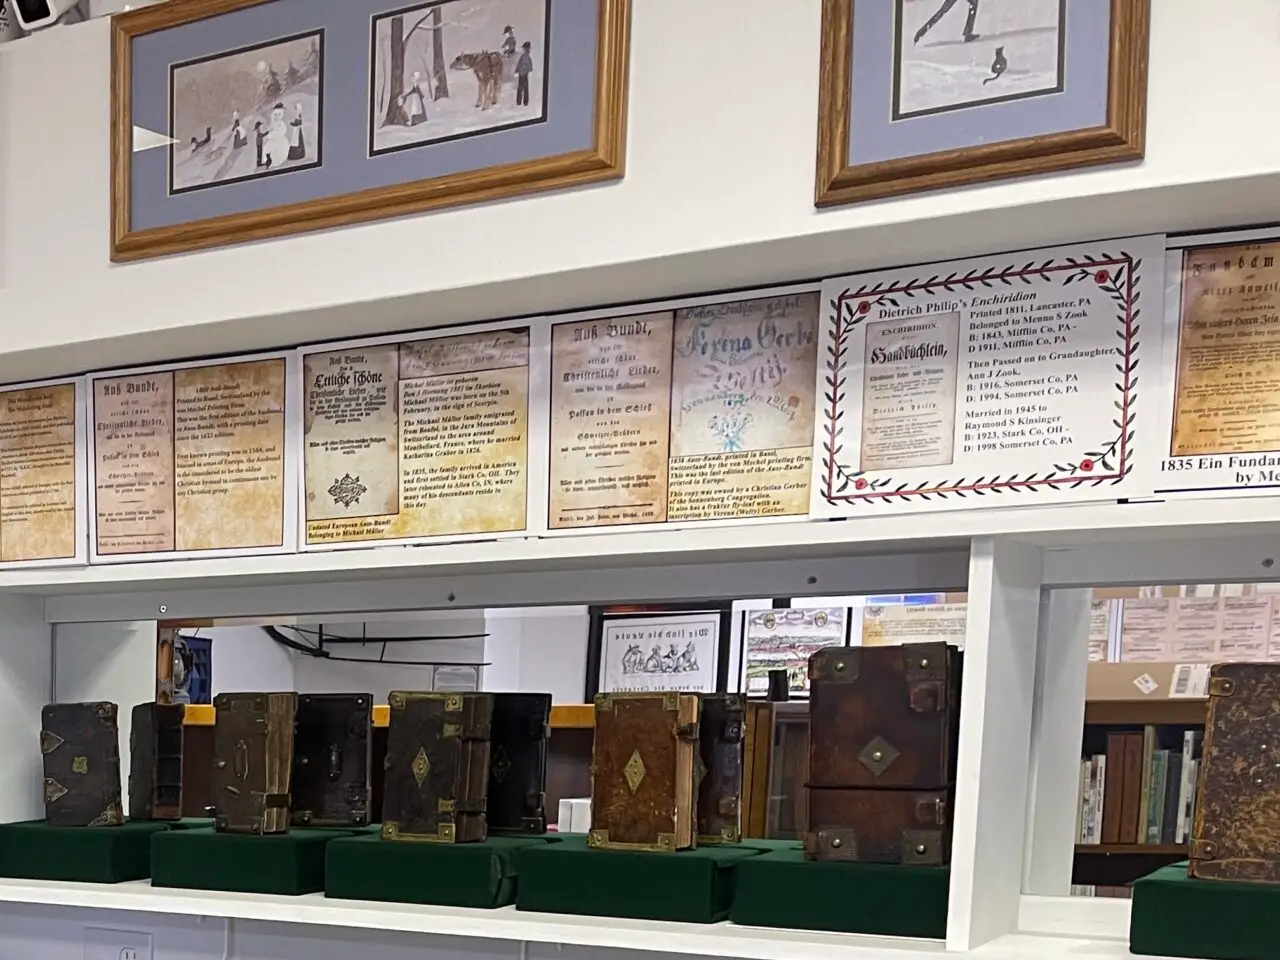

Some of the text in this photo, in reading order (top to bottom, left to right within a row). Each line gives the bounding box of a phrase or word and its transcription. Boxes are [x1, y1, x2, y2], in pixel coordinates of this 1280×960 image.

[879, 292, 1037, 319] Dietrich Philip's Enchiridion
[970, 308, 1002, 318] Printed
[1030, 301, 1077, 312] Lancaster,
[969, 318, 1009, 330] Belonged
[1012, 318, 1021, 326] to
[1023, 315, 1054, 324] Menno
[1065, 310, 1088, 319] Zook
[969, 323, 1071, 341] B: 1843, Mifflin Co, PA
[968, 345, 975, 353] D
[978, 343, 1000, 352] 1911,
[1003, 339, 1034, 349] Mifflin
[1036, 337, 1052, 346] Co,
[968, 360, 989, 368] Then
[992, 356, 1022, 366] Passed
[1049, 347, 1117, 361] Grandaughter,
[967, 373, 1078, 392] B: 1916, Somerset Co, PA
[968, 372, 986, 380] Ann
[966, 385, 1078, 403] D: 1994, Somerset Co, PA
[965, 408, 1002, 418] Married
[1016, 405, 1036, 414] 1945
[965, 415, 1061, 431] Raymond S Kinsinger
[964, 426, 1062, 441] B: 1923, Stark Co, OH
[964, 436, 1073, 452] D: 1998 Somerset Co, PA
[670, 463, 707, 471] Switzerland
[708, 463, 715, 472] by
[767, 457, 794, 466] printing
[725, 453, 748, 461] printed
[1160, 459, 1193, 472] 1835
[1199, 456, 1223, 470] Ein
[670, 479, 693, 487] printed
[1236, 472, 1254, 486] by
[751, 484, 782, 492] Christian
